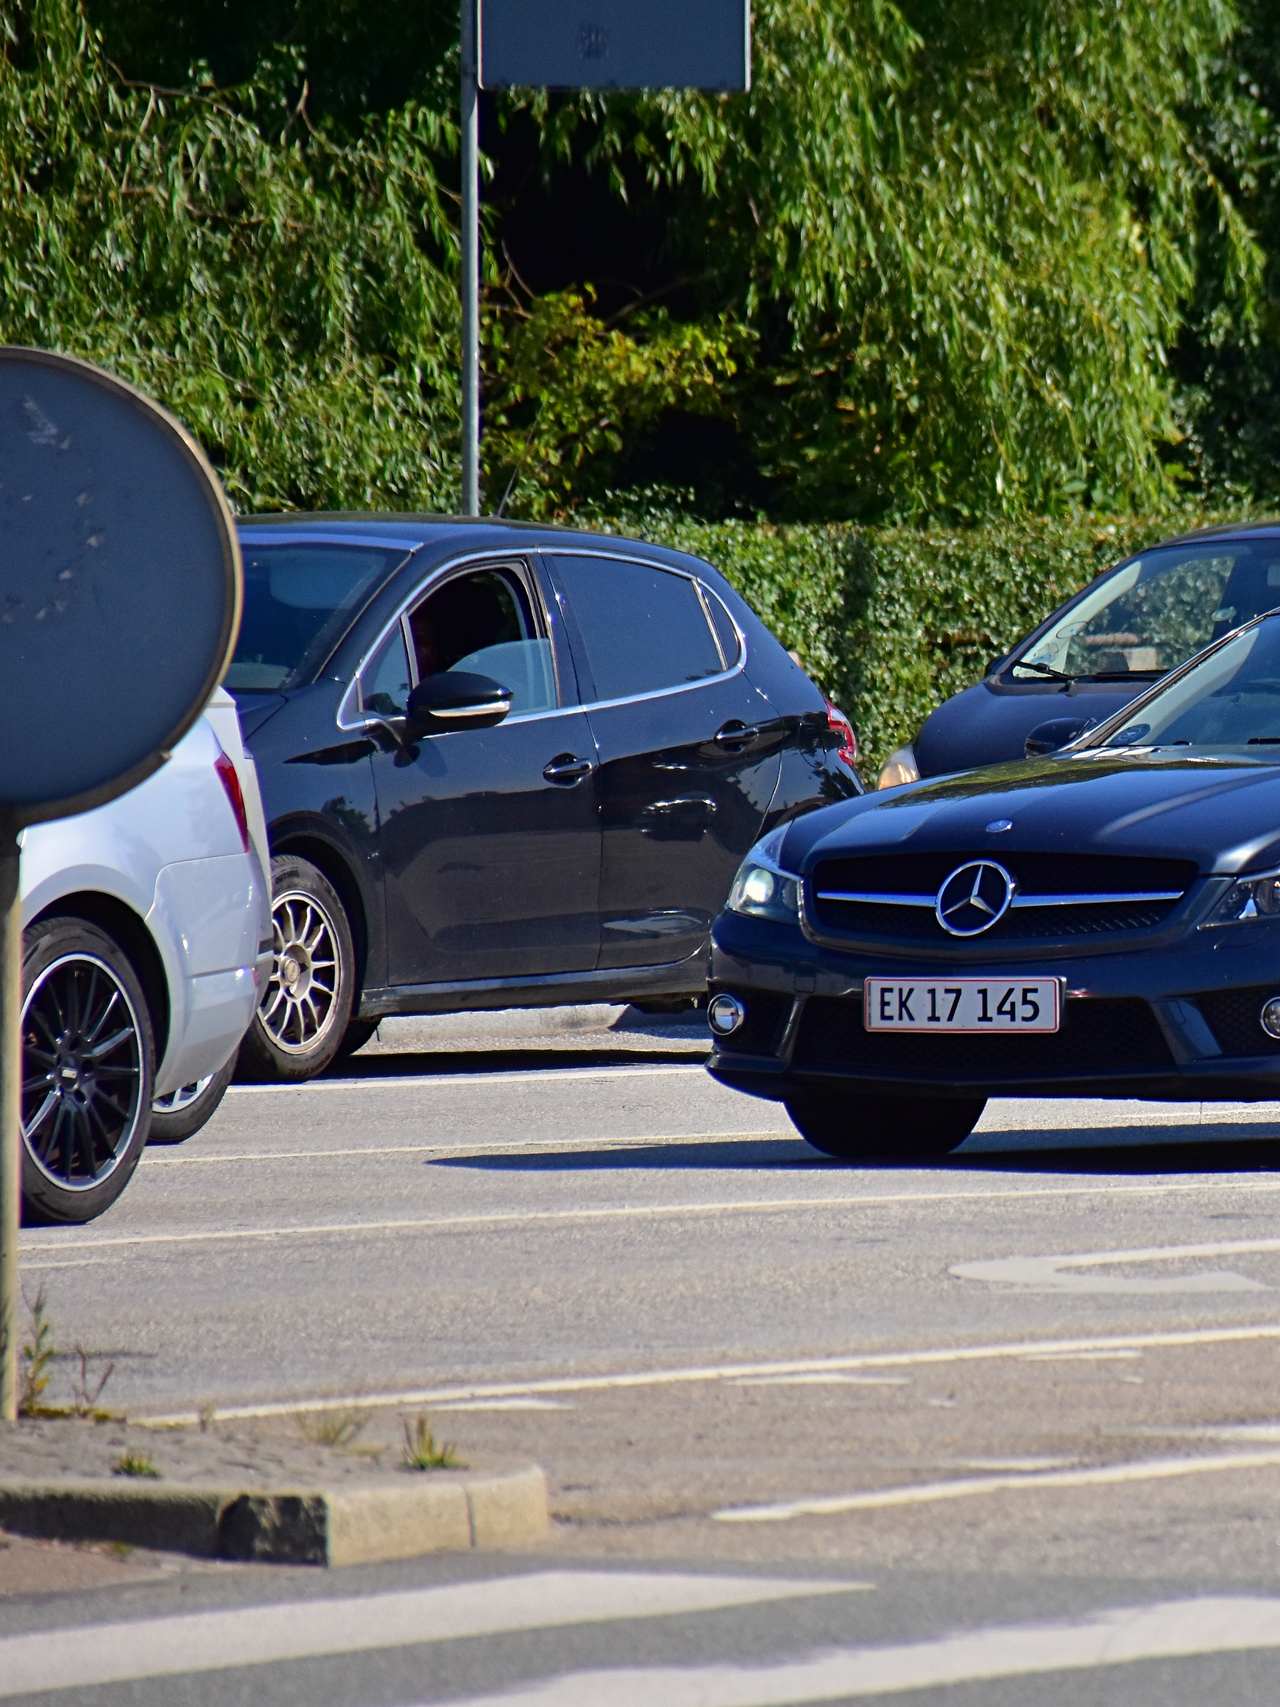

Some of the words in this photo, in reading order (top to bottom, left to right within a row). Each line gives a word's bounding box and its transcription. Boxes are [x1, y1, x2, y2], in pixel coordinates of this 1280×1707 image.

[880, 987, 915, 1022] EK
[927, 987, 962, 1022] 17
[977, 987, 1040, 1022] 145
